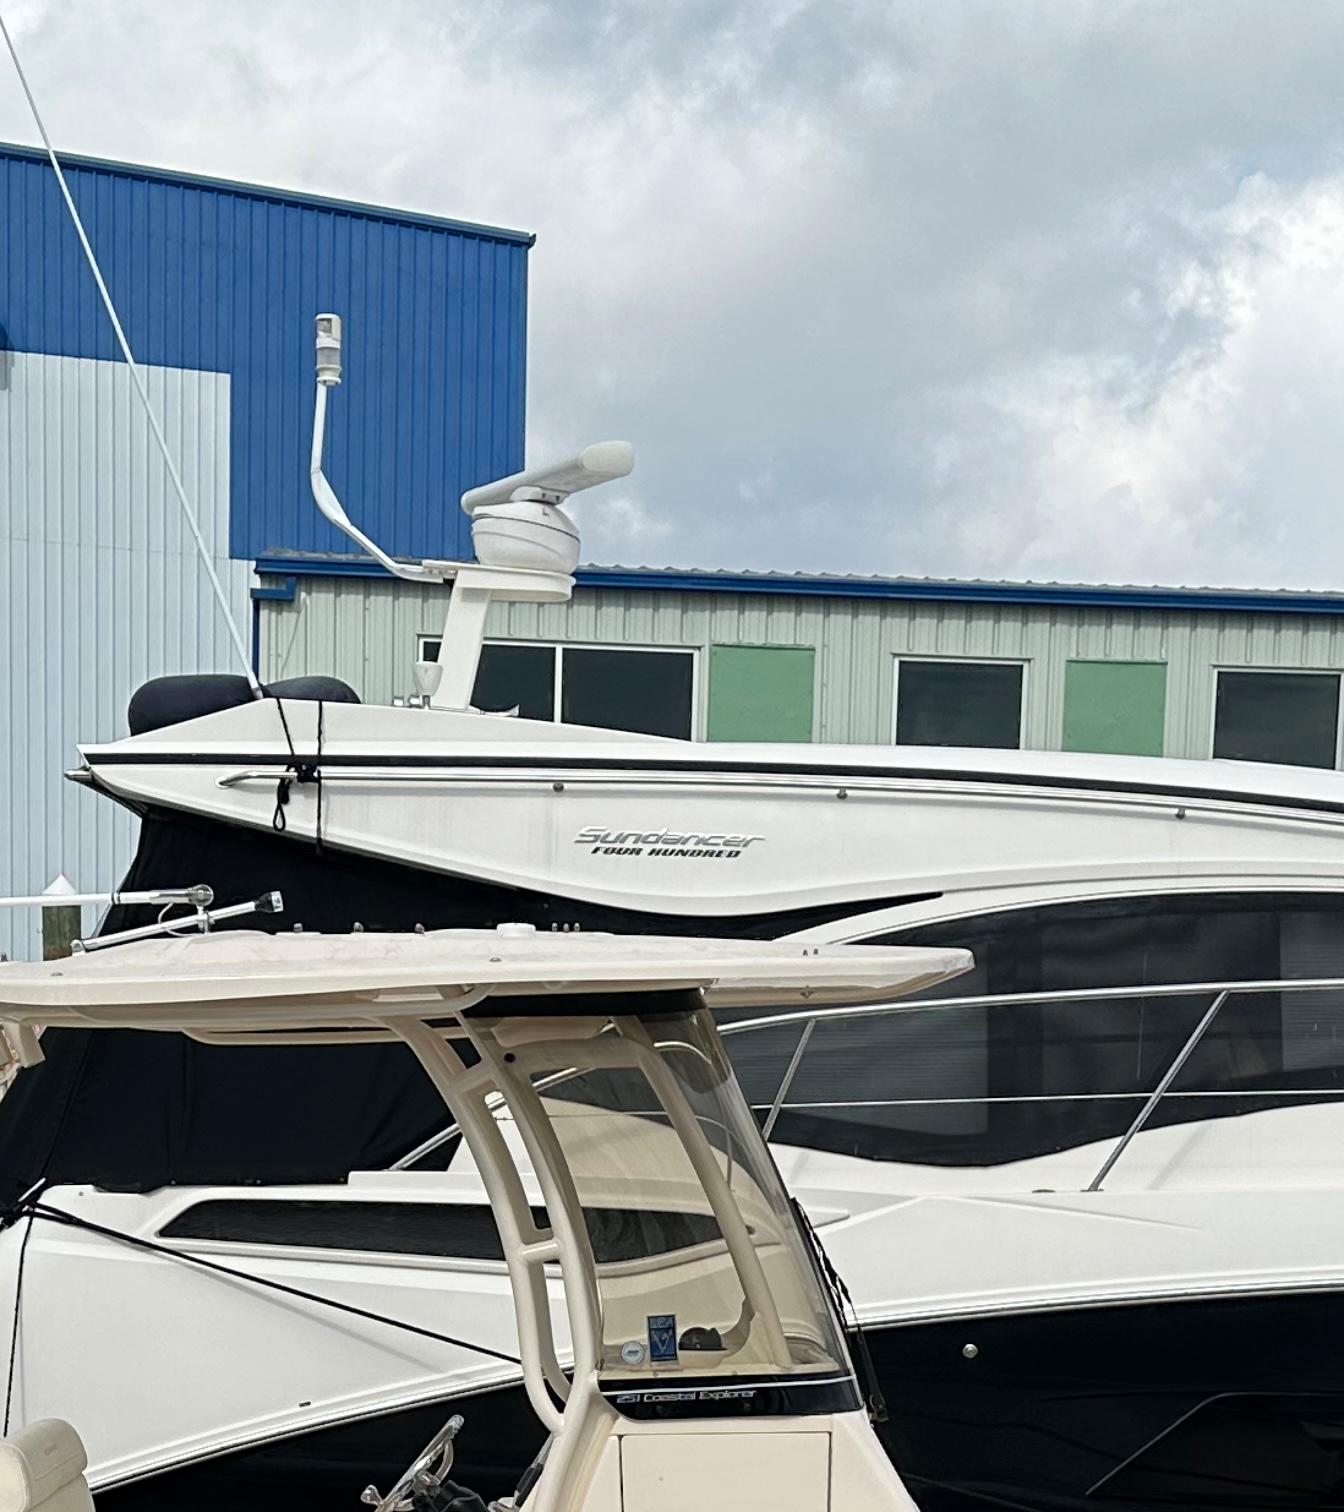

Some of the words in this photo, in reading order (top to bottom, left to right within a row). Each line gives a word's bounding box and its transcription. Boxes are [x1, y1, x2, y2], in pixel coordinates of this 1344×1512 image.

[574, 826, 766, 848] Sundancer
[591, 846, 644, 856] FOUR
[647, 847, 742, 859] HUNDRED
[616, 1393, 641, 1404] 251
[643, 1391, 697, 1403] Coastal
[699, 1390, 758, 1401] Explorer
